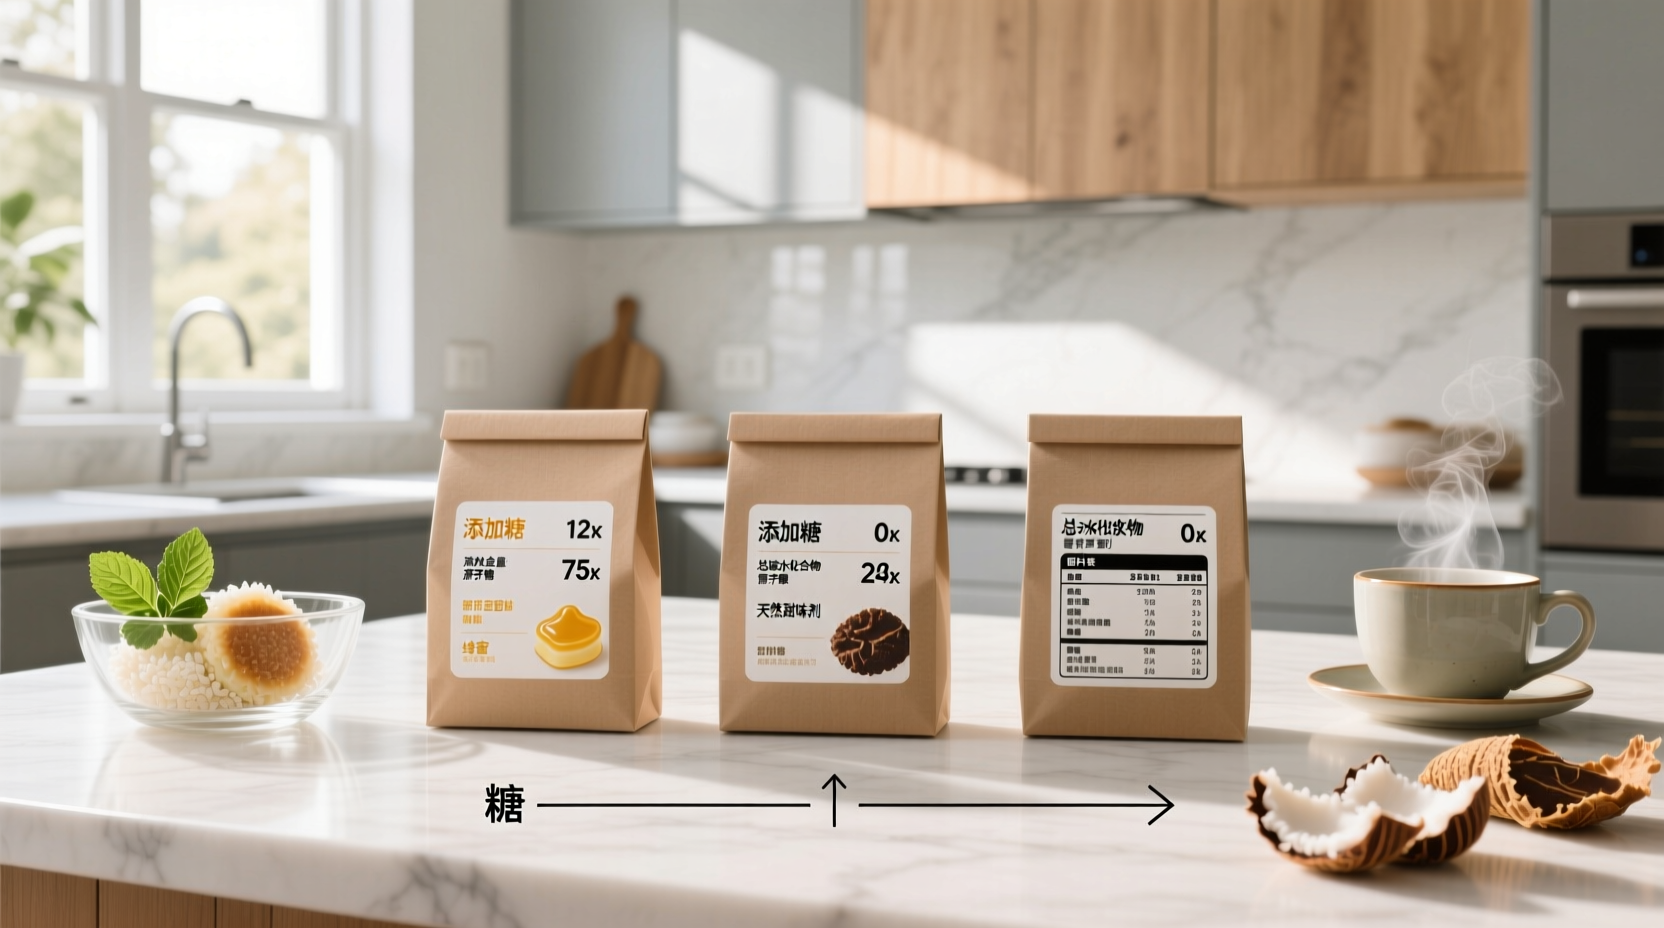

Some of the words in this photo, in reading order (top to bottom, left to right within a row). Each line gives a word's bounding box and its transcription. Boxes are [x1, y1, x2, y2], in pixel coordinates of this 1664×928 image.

[463, 517, 526, 540] 添加糖
[567, 519, 603, 539] 12x
[758, 520, 822, 543] 添加糖
[874, 522, 900, 543] 0x
[1181, 523, 1207, 543] 0x
[562, 559, 601, 581] 75x
